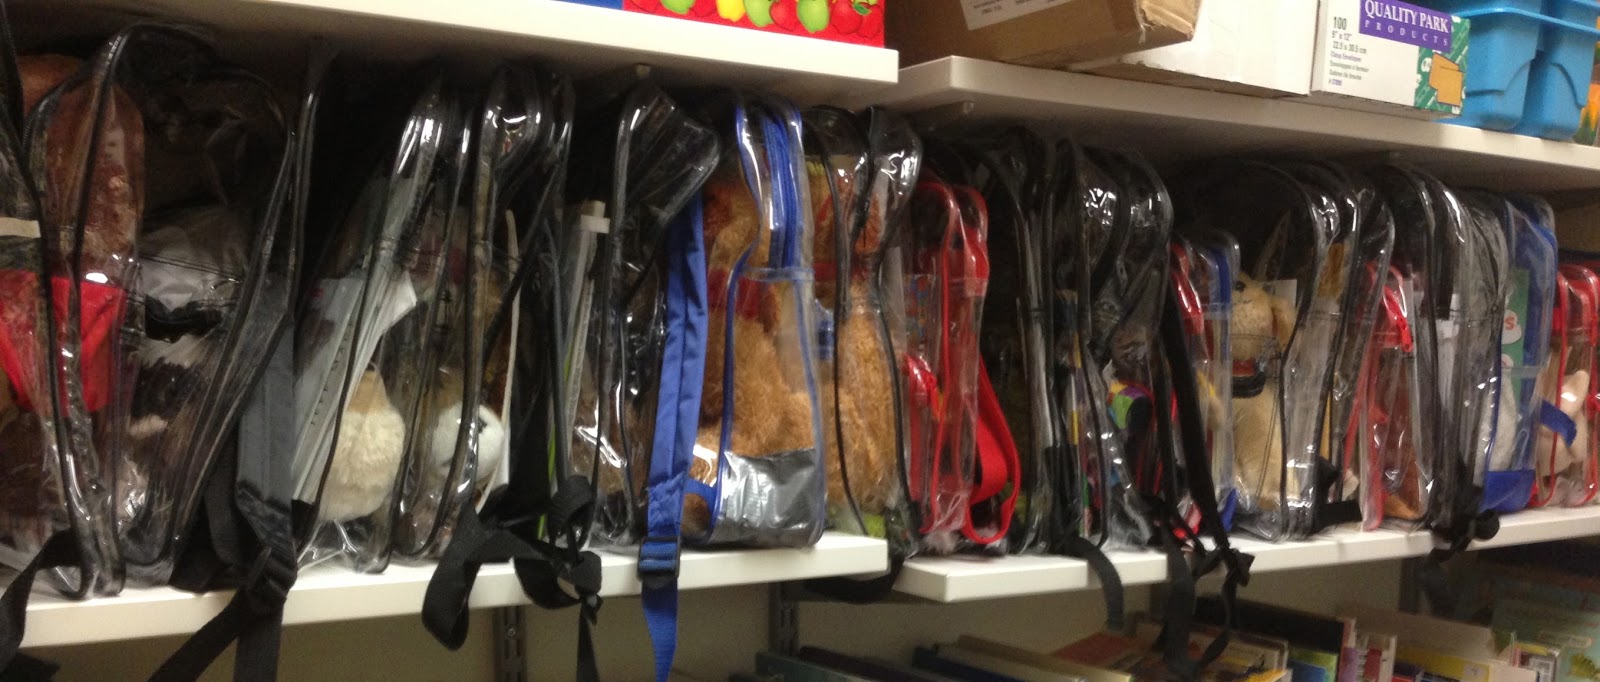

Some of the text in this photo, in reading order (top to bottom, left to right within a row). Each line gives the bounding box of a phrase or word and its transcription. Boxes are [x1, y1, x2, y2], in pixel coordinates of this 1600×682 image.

[1333, 17, 1347, 30] 100
[1365, 0, 1449, 33] QUALITY PARK
[1364, 20, 1448, 46] PRODUCTS
